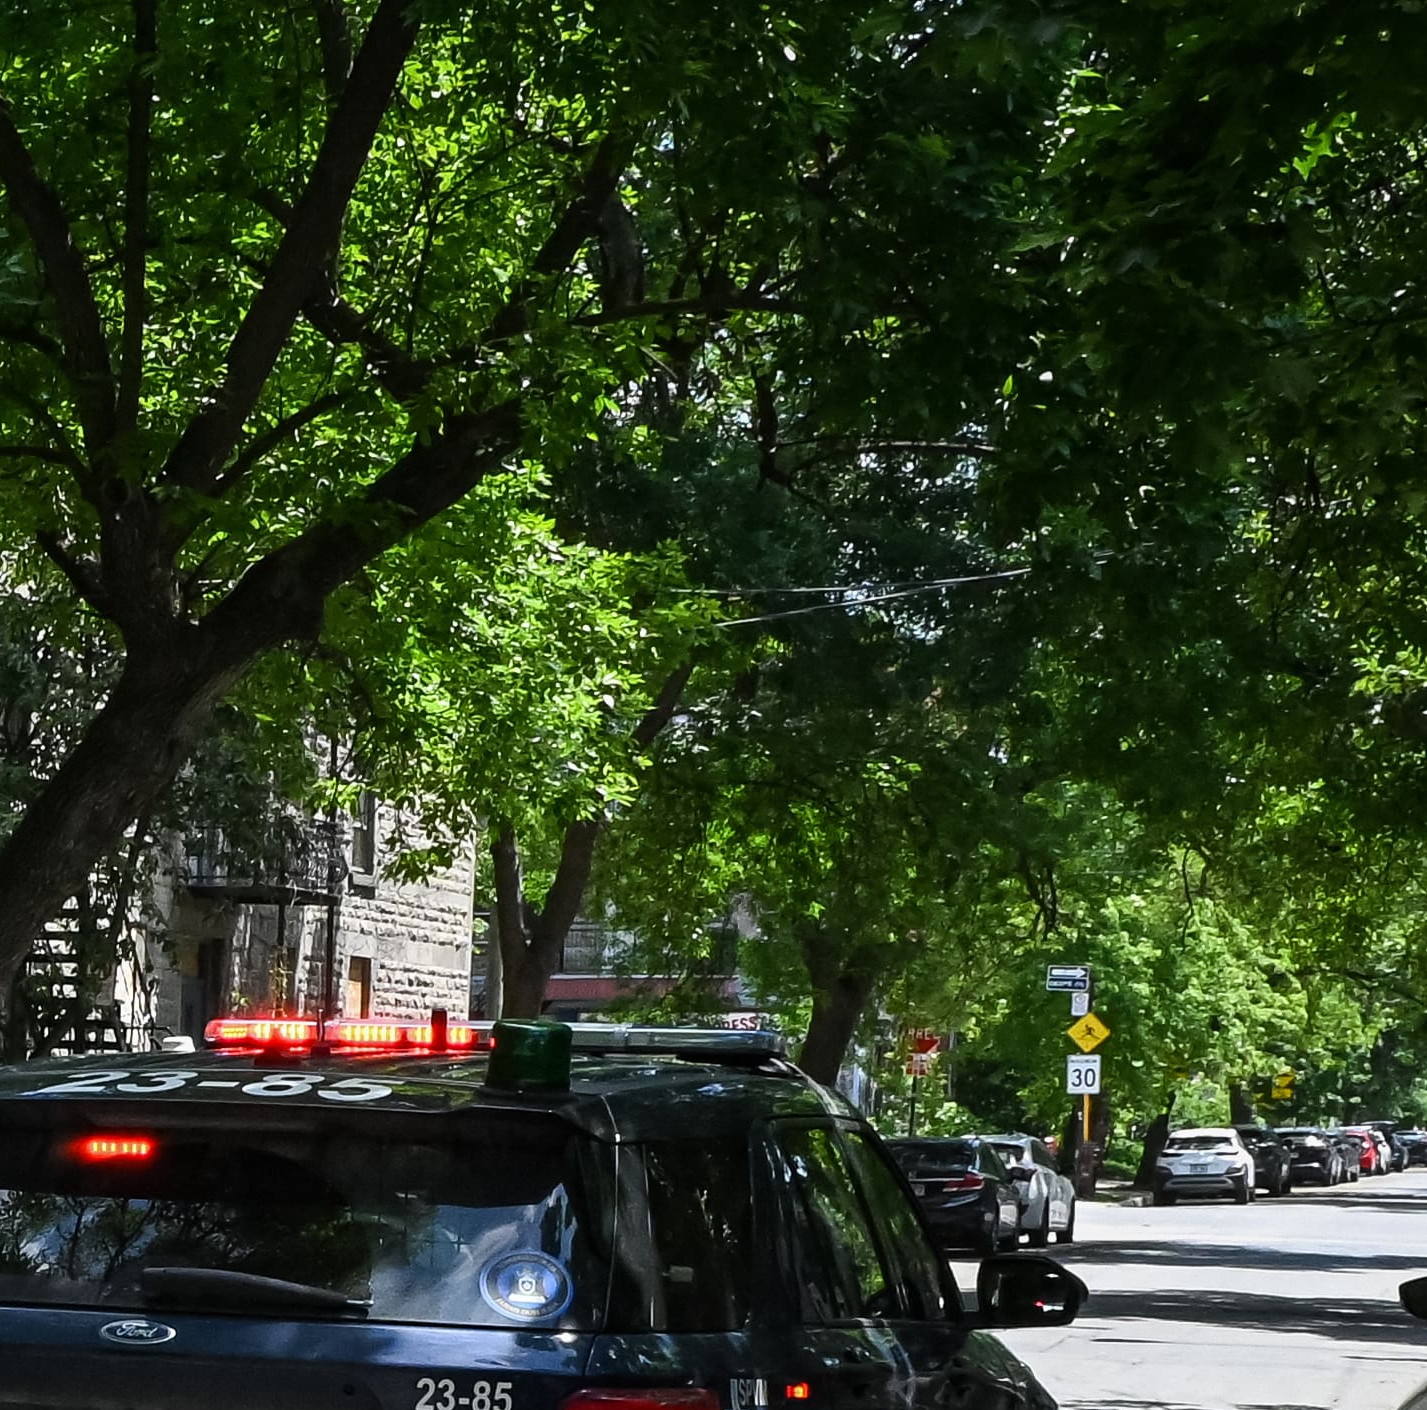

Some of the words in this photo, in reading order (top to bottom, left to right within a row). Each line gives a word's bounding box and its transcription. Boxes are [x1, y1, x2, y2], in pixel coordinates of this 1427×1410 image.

[20, 1070, 407, 1101] 23-85
[1071, 1068, 1096, 1087] 30
[116, 1322, 158, 1338] Ford
